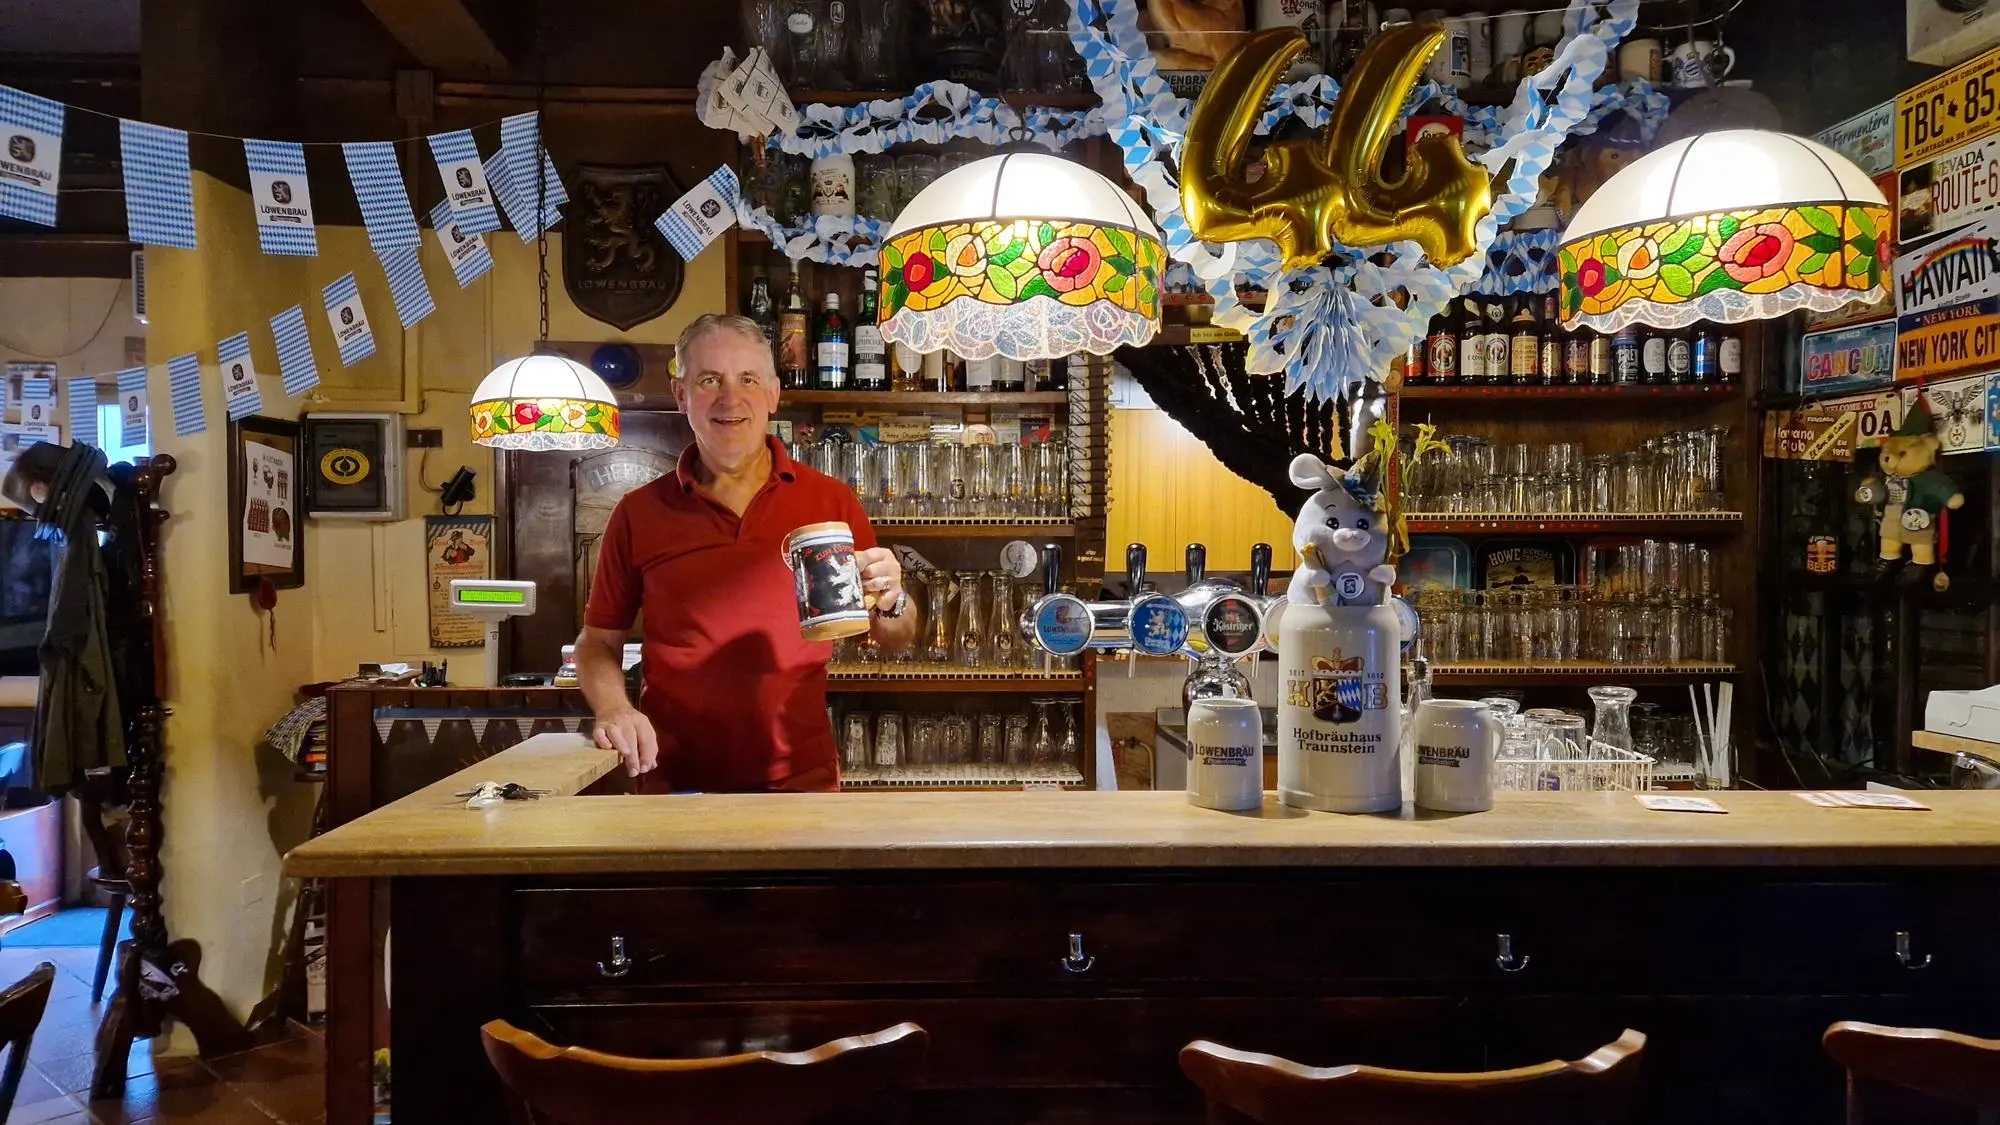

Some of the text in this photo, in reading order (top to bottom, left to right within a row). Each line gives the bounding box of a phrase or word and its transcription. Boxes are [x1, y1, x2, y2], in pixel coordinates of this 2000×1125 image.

[1950, 74, 1960, 85] DE
[1960, 58, 1994, 80] COLOMBIA
[1901, 66, 2000, 151] TBC 85
[1916, 136, 1955, 156] CARTAGENA
[1956, 131, 1965, 141] DE
[0, 160, 52, 181] WENBRÄU
[1901, 242, 1986, 311] HAWAII
[1922, 303, 1982, 327] NEW YORK
[1807, 337, 1891, 381] CANCÚN
[1900, 337, 1928, 369] NEW
[1931, 328, 1969, 364] YORK
[1863, 401, 1874, 410] TO
[1488, 548, 1521, 567] HOWE
[1807, 560, 1836, 573] BEER
[1287, 680, 1389, 710] H B
[1293, 728, 1382, 742] Hofbräuhaus
[1297, 739, 1376, 754] Traunstein
